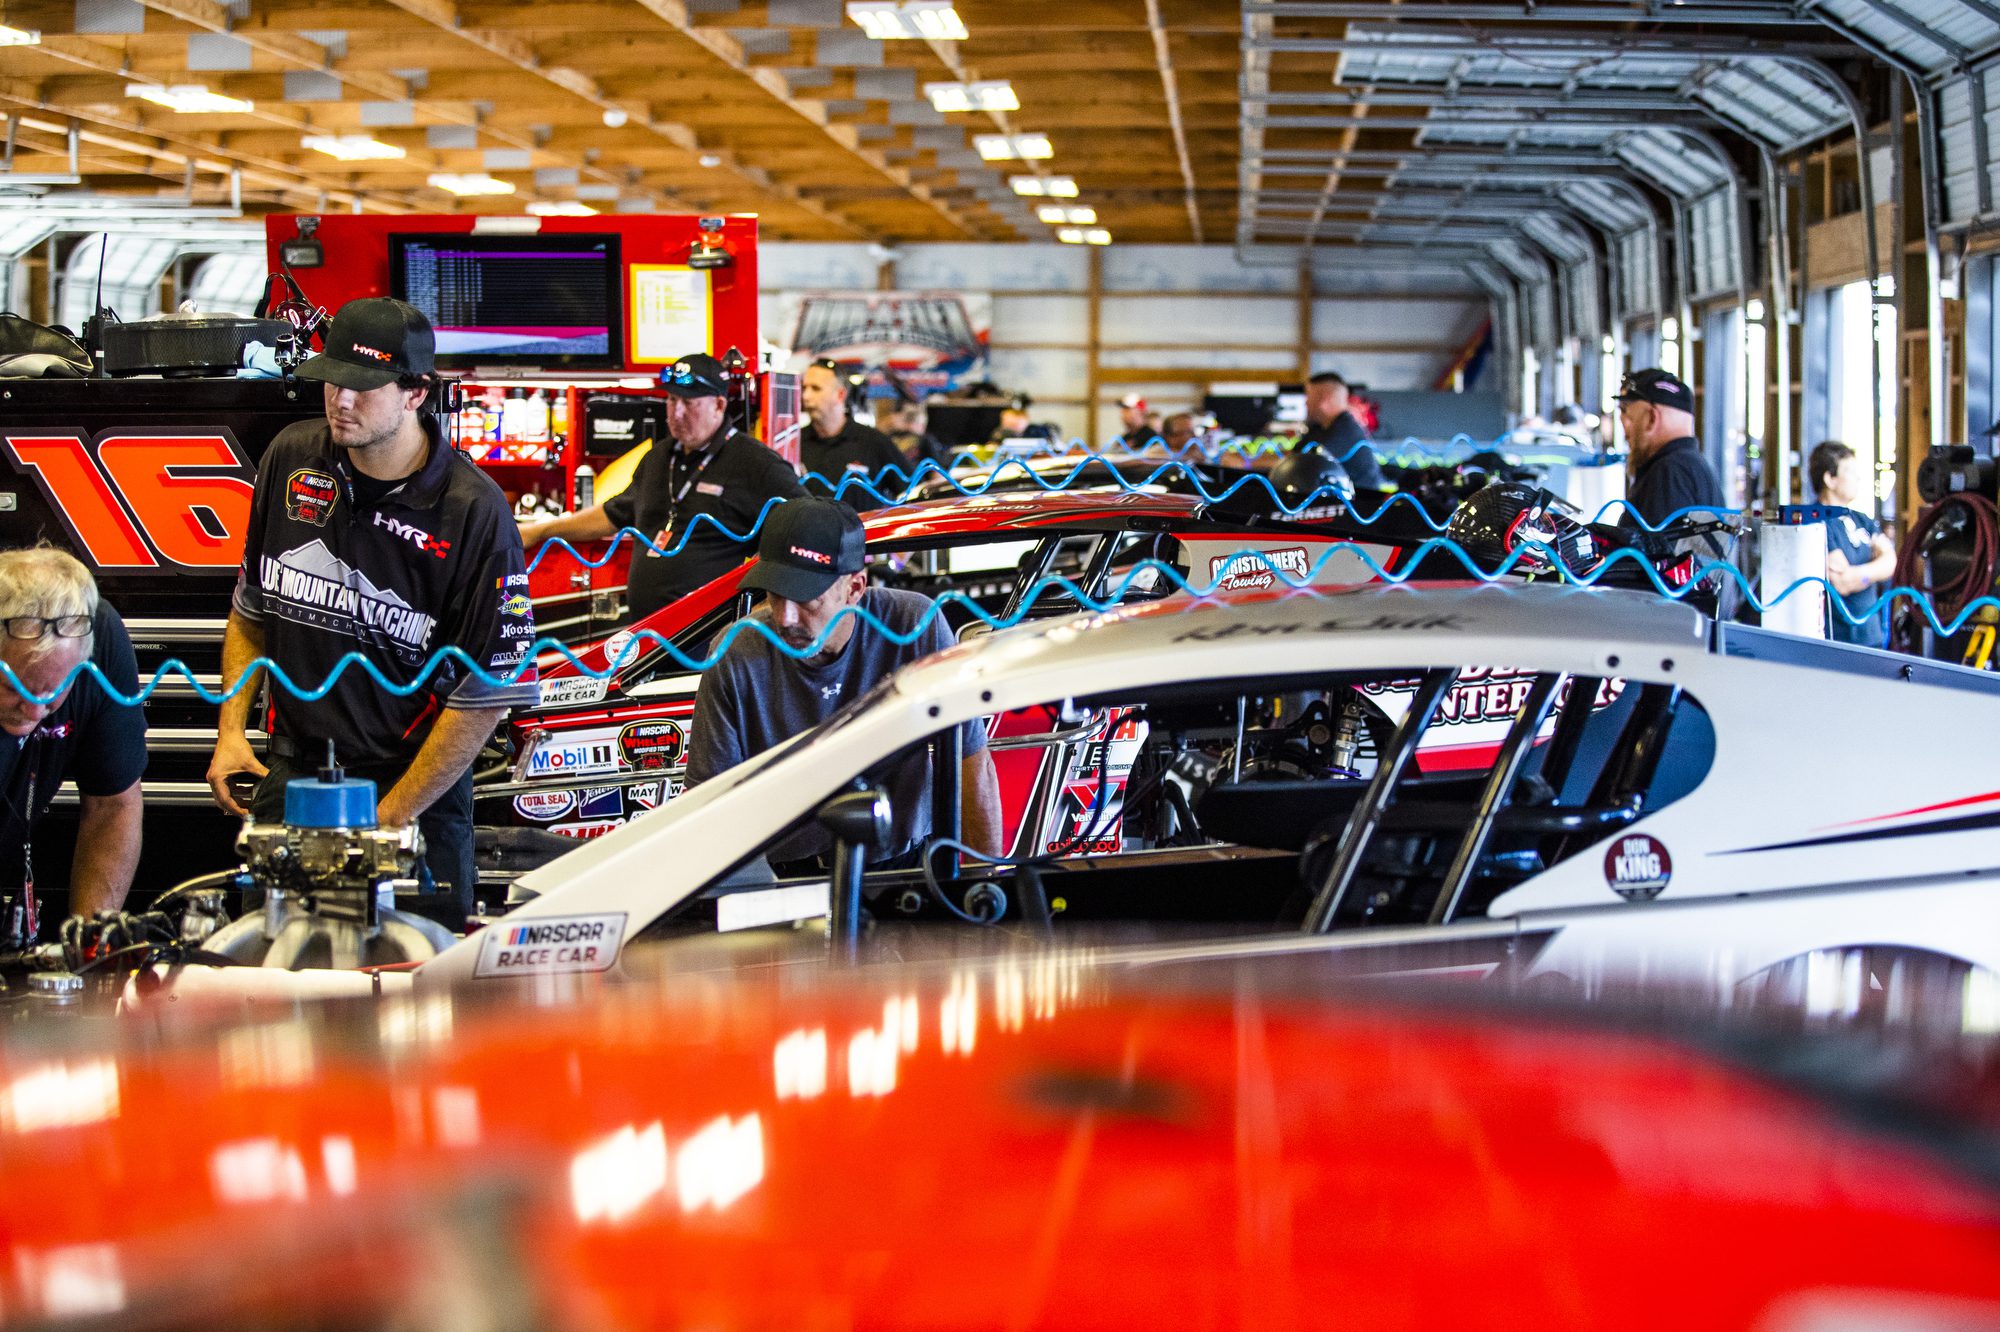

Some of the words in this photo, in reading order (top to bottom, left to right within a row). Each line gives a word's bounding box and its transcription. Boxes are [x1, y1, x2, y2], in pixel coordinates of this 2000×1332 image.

[291, 480, 335, 501] WHELEN
[5, 436, 255, 567] 16
[1221, 574, 1272, 590] Towing
[260, 554, 281, 593] LUE
[361, 597, 437, 651] MACHINE
[503, 600, 532, 612] SUNOC
[500, 622, 536, 638] Hoosi
[558, 680, 599, 694] NASCAR
[543, 693, 571, 703] RACE
[574, 690, 596, 700] CAR
[1430, 676, 1627, 719] NTERORS
[640, 725, 671, 736] NASCAR
[623, 732, 678, 748] WHELEN
[532, 747, 587, 769] Mobil
[595, 745, 609, 763] 1
[522, 795, 546, 807] TOTAL
[547, 794, 568, 804] SEAL
[1071, 811, 1118, 822] Valvlin
[1615, 853, 1661, 880] KING
[526, 923, 604, 945] NASCAR
[497, 949, 550, 967] RACE
[557, 947, 597, 963] CAR
